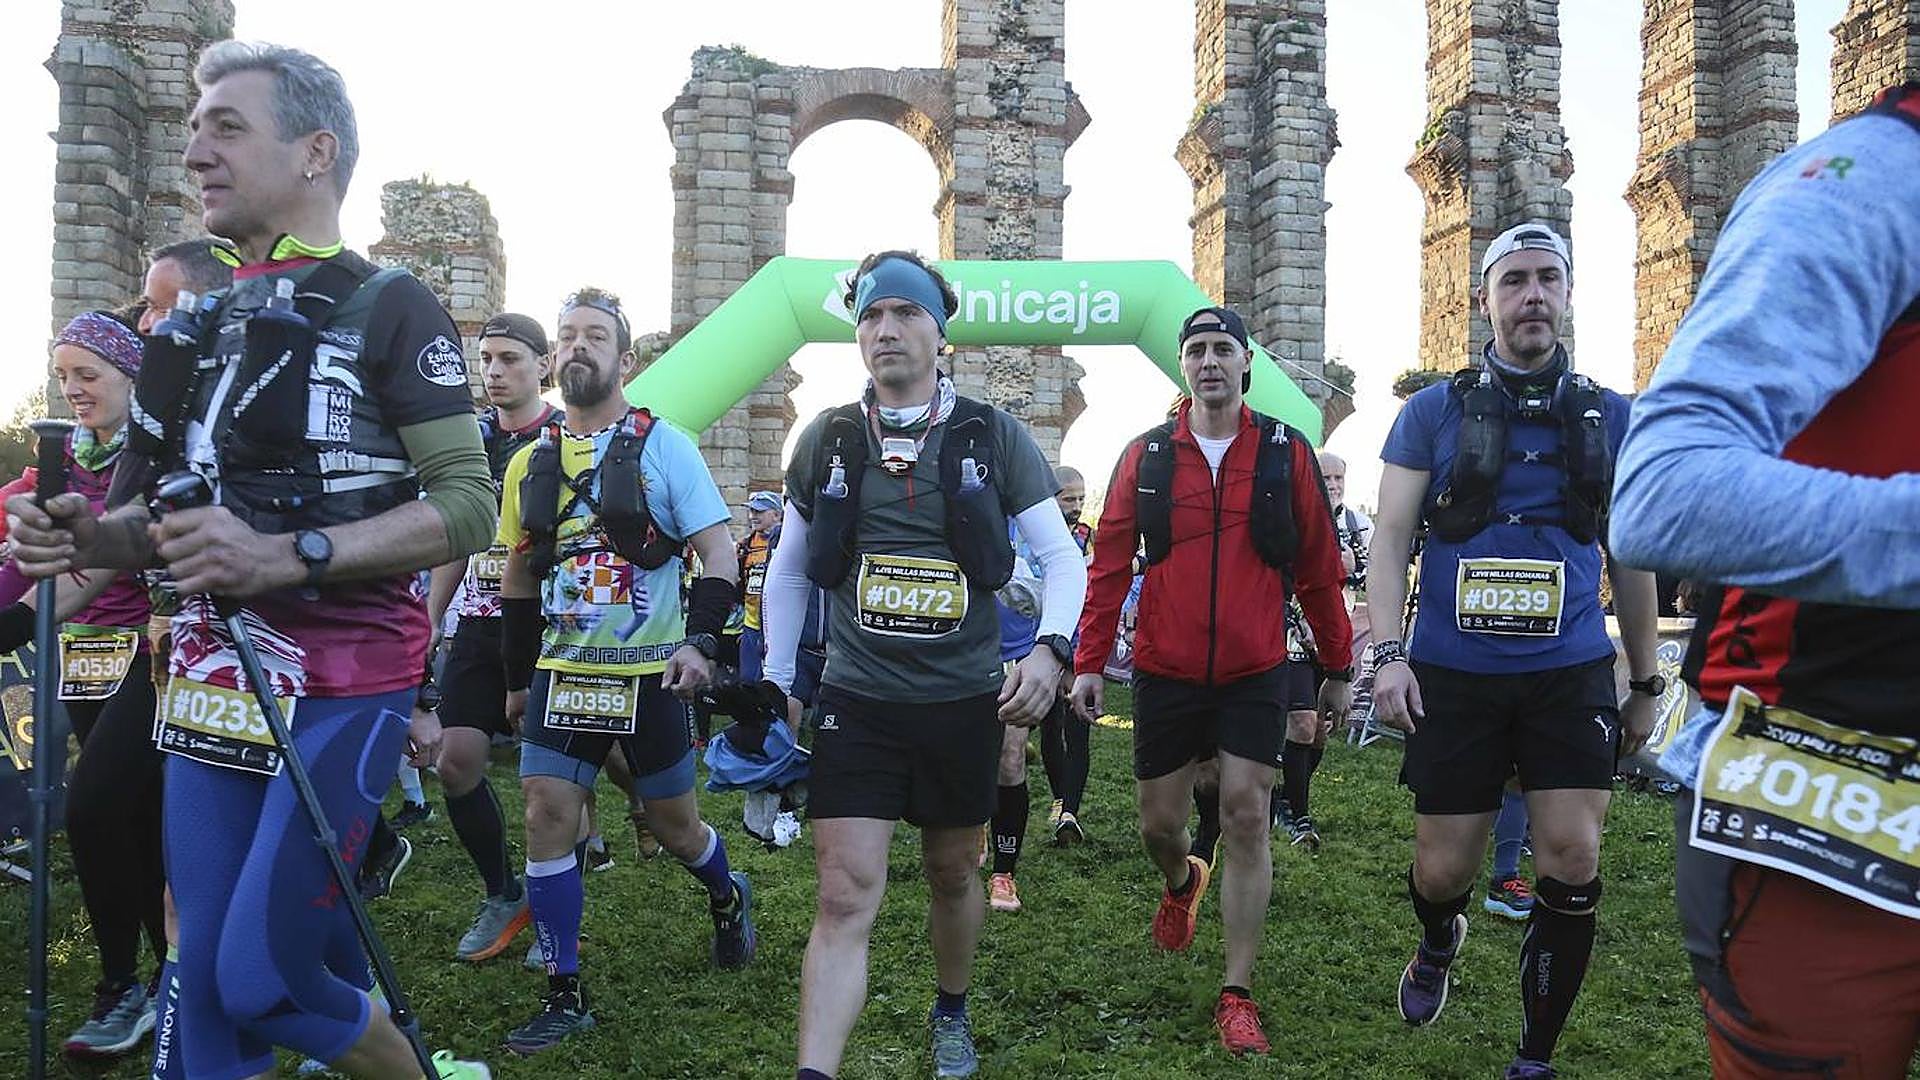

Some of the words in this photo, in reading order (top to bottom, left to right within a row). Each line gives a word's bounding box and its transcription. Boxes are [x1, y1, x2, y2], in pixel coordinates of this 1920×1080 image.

[866, 585, 953, 613] #0472
[1464, 588, 1550, 612] #0239
[67, 657, 127, 677] #0530
[173, 688, 270, 736] #0233
[554, 691, 626, 713] #0359
[1717, 752, 1920, 854] #0184
